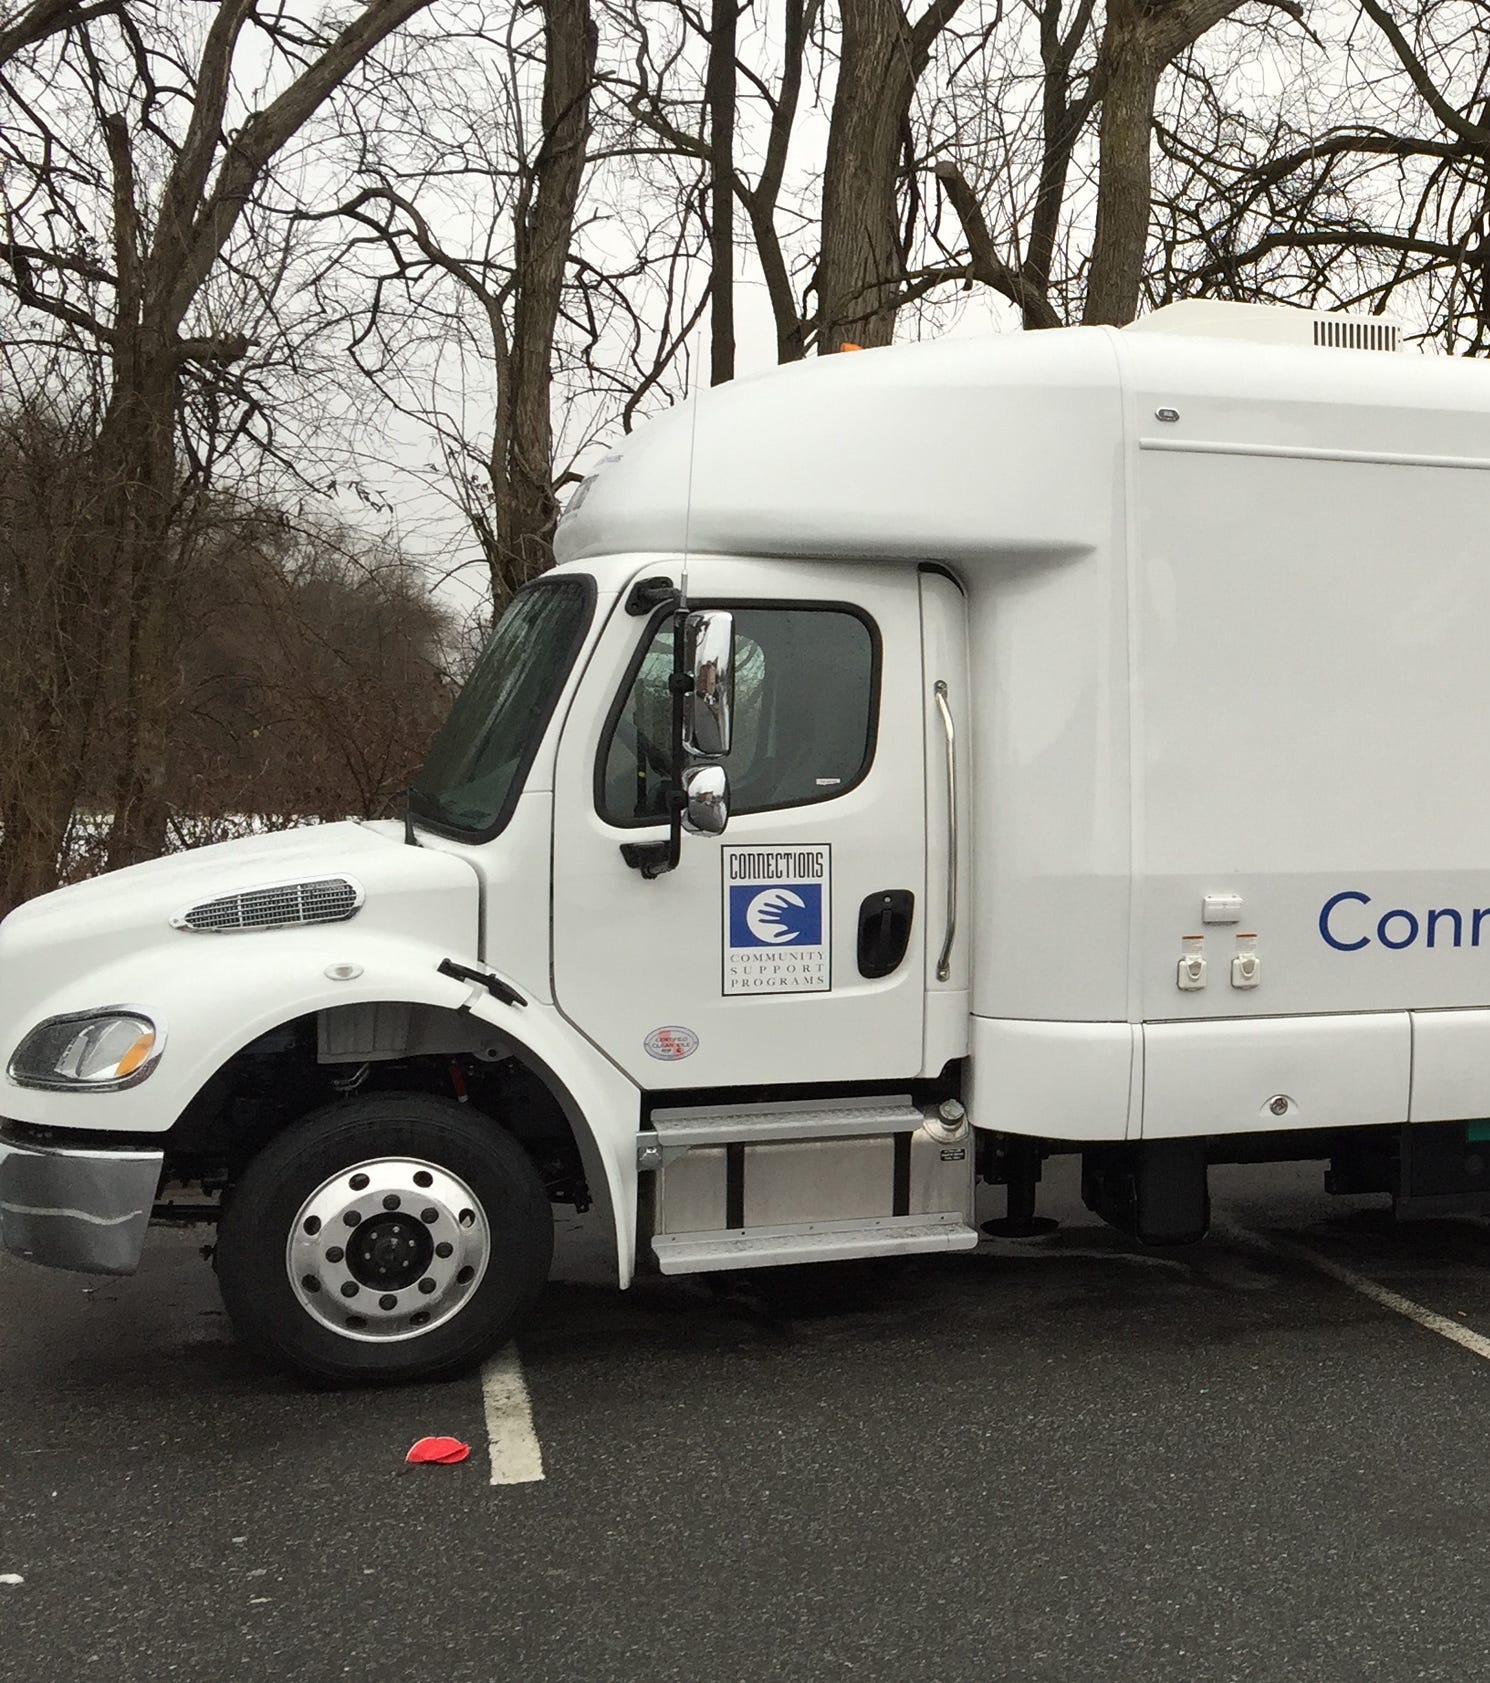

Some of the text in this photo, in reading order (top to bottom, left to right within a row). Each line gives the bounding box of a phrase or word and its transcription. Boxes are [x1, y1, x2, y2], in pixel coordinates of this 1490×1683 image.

[730, 852, 824, 880] CONNECTIONS
[730, 951, 824, 962] COMMUNITY
[729, 963, 824, 975] SUPPORT
[731, 975, 824, 988] PROGRAMS
